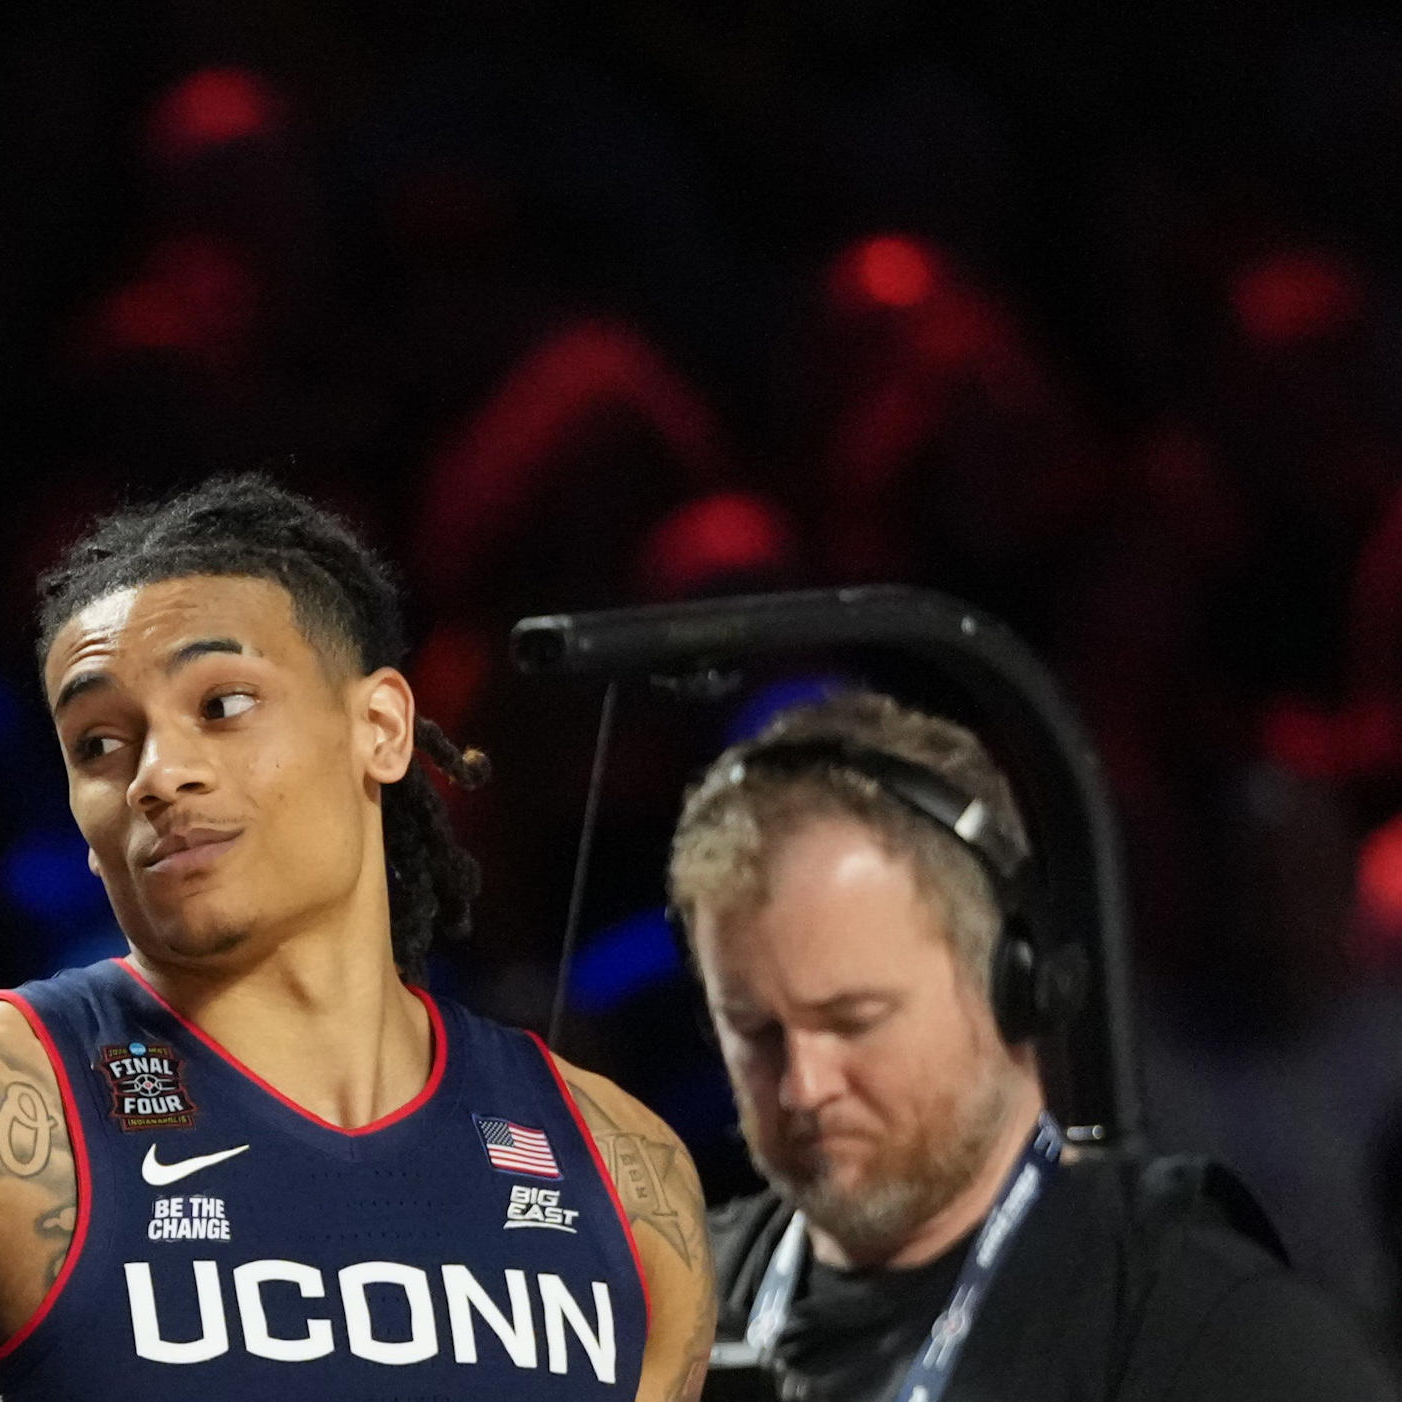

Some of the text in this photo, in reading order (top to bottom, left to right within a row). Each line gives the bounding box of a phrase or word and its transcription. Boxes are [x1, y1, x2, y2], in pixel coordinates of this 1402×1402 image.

[109, 1057, 173, 1078] FINAL
[124, 1095, 184, 1114] FOUR
[510, 1185, 560, 1207] BIG
[154, 1197, 226, 1218] BE THE
[507, 1202, 580, 1226] EAST
[148, 1218, 231, 1240] CHANGE
[124, 1260, 616, 1383] UCONN
